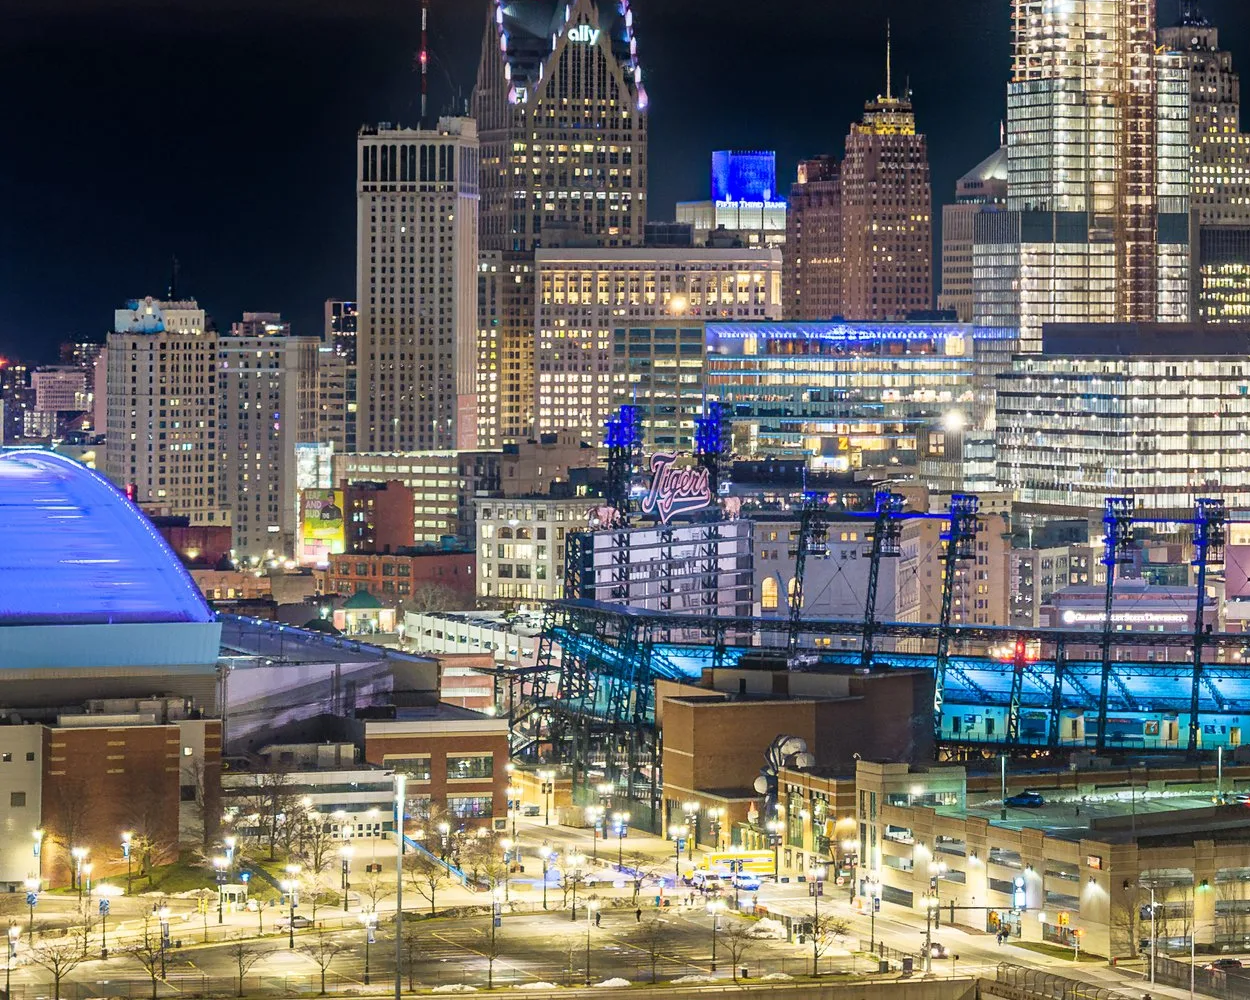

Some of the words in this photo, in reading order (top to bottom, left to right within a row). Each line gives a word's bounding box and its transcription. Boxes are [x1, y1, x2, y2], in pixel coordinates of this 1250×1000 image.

[568, 25, 600, 46] ally
[716, 200, 738, 208] FIFTH
[739, 200, 763, 208] THIRD
[642, 451, 710, 524] Tigers
[305, 501, 322, 509] AND
[305, 509, 320, 518] BUD
